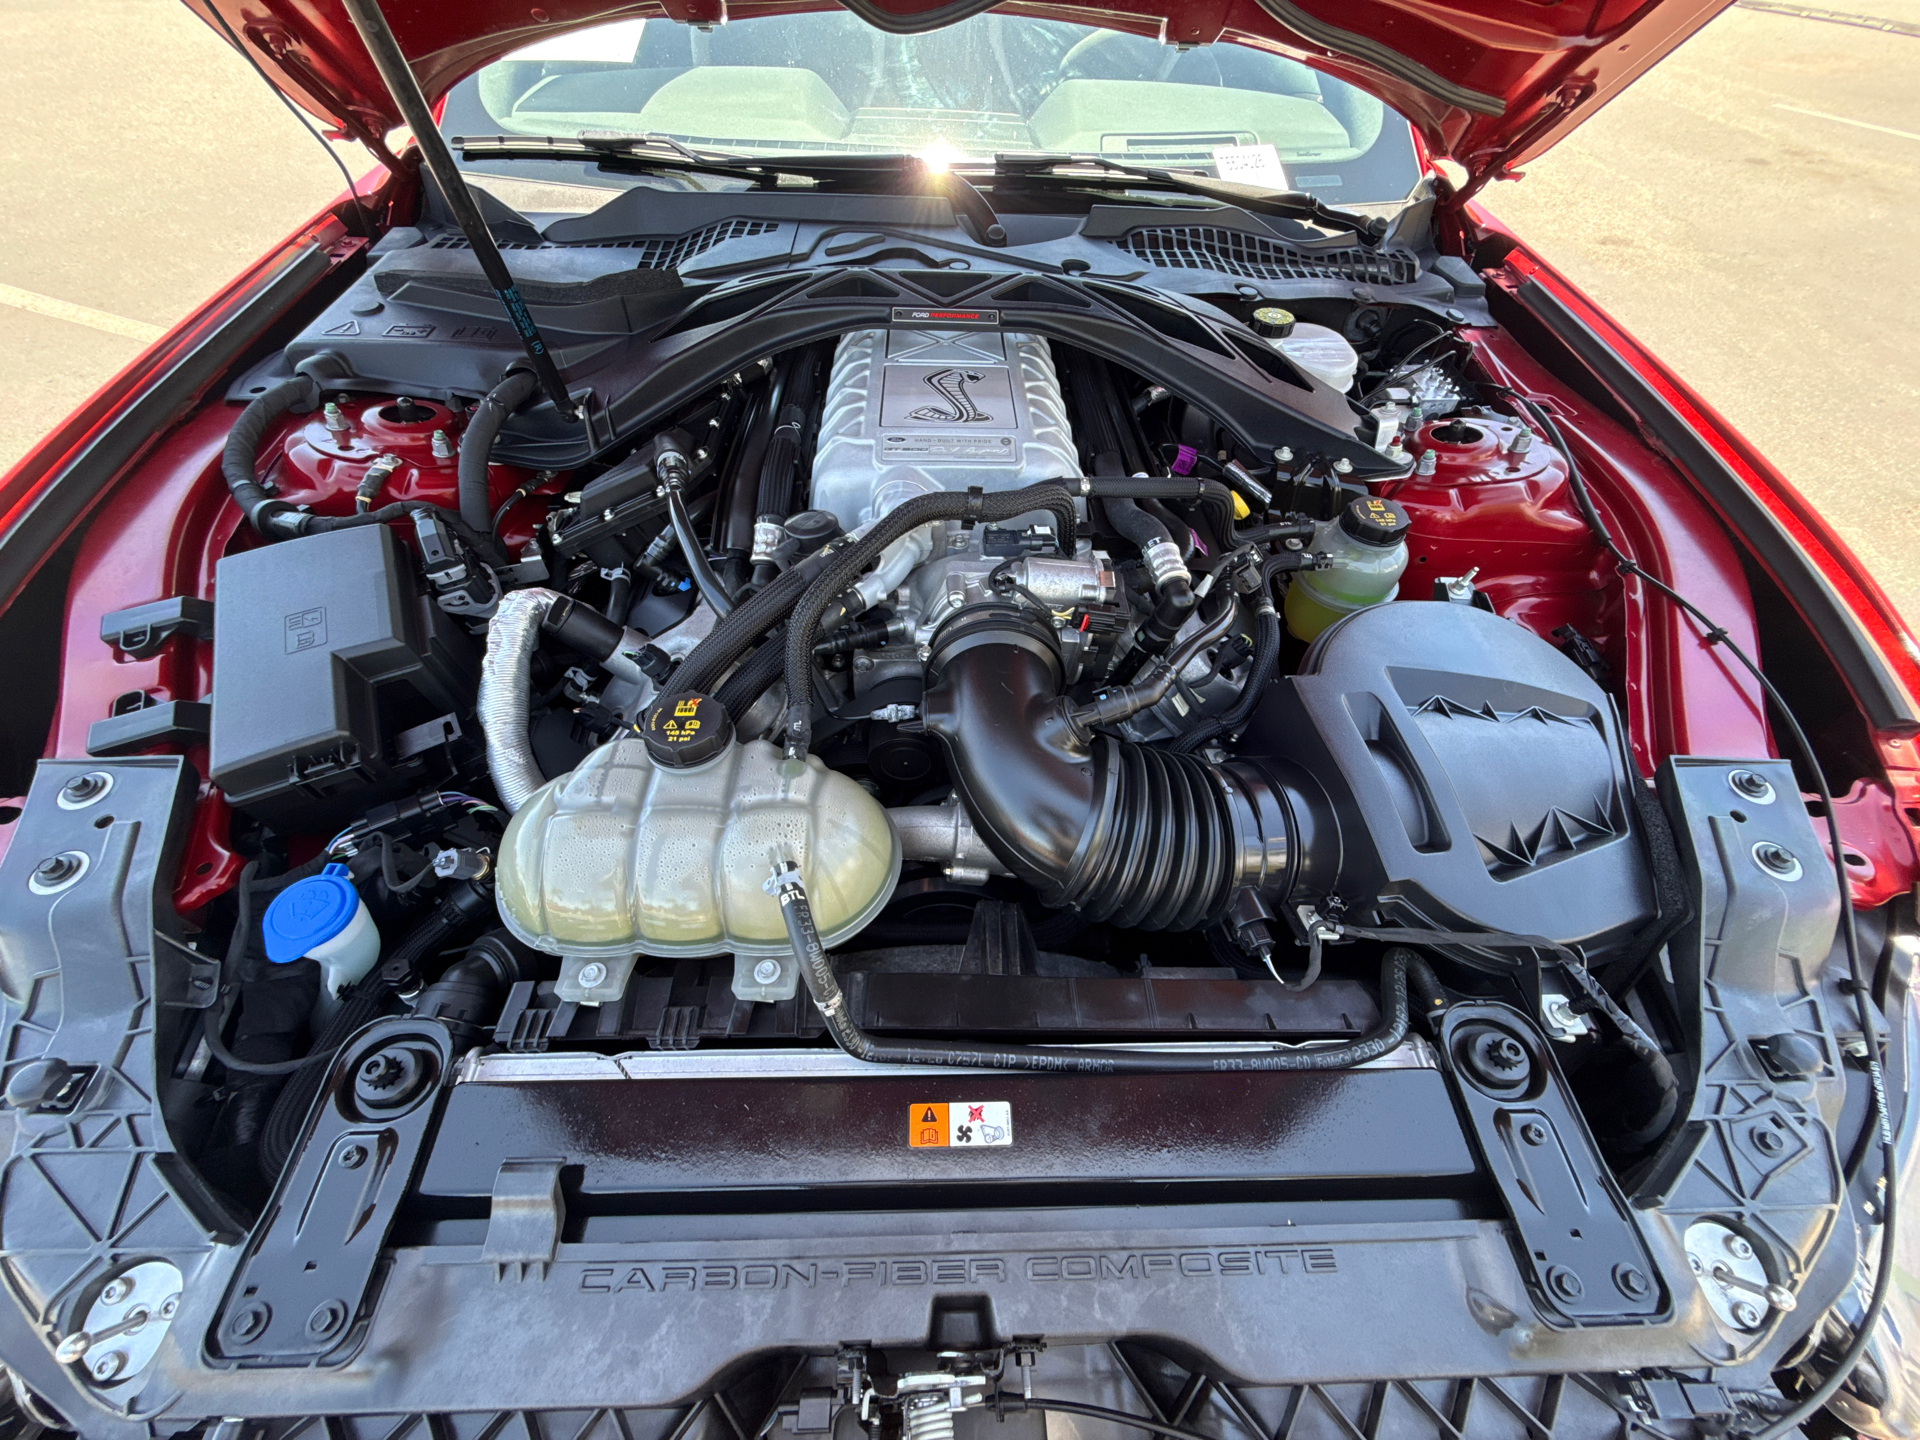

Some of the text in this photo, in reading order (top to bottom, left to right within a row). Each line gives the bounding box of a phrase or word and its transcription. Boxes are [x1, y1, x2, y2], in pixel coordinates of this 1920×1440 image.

[930, 312, 980, 320] PERFORMANCE
[780, 890, 806, 907] BTL
[1352, 1038, 1385, 1061] 2330
[1024, 1055, 1070, 1071] >EPDM<
[1077, 1058, 1115, 1073] ARMOR
[578, 1248, 1338, 1294] CARBON-FIBER COMPOSITE
